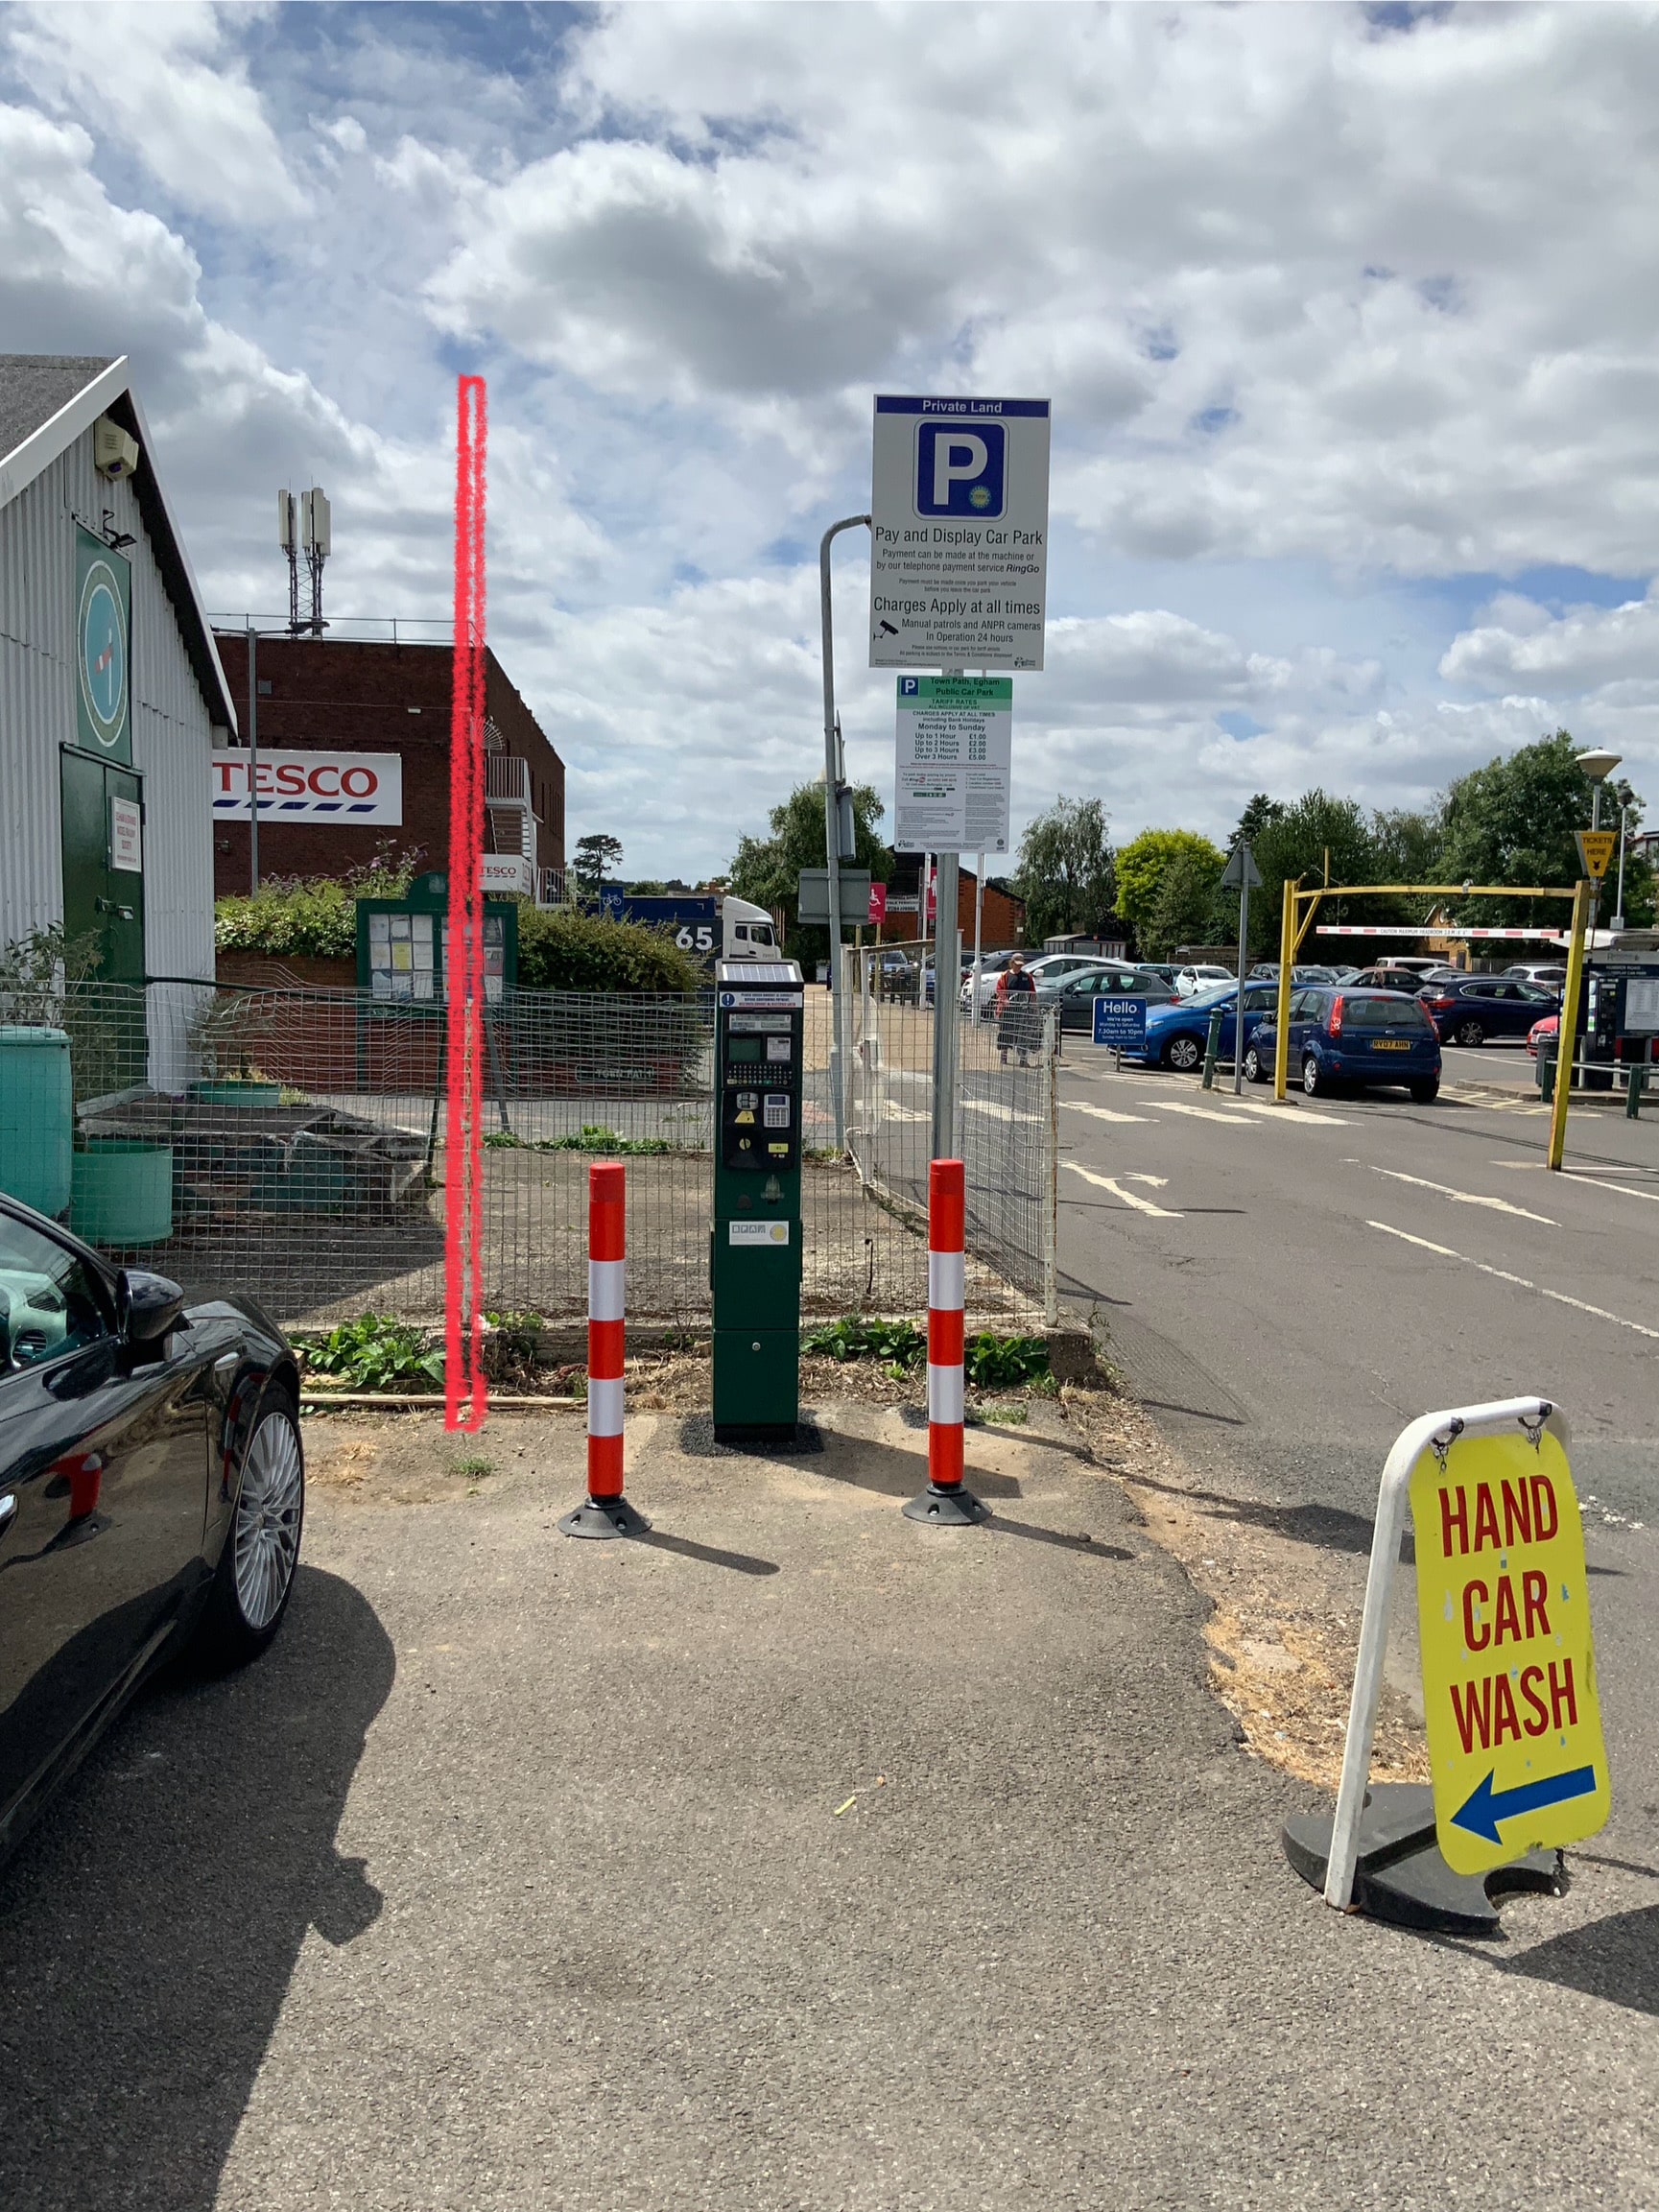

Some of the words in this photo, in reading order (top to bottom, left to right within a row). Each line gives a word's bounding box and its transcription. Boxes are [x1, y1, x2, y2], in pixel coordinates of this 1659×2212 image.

[922, 399, 967, 413] Private
[971, 401, 1003, 414] Land
[933, 433, 988, 505] P
[875, 527, 900, 544] Pay
[904, 528, 929, 542] and
[933, 528, 982, 546] Display
[986, 530, 1008, 544] Car
[1013, 530, 1043, 545] Park
[883, 549, 915, 560] Payment
[934, 550, 942, 559] be
[945, 550, 966, 559] made
[968, 551, 976, 559] at
[978, 551, 990, 560] the
[992, 551, 1024, 560] machine
[877, 560, 887, 571] by
[903, 561, 940, 572] telephone
[942, 562, 976, 573] payment
[977, 563, 1005, 572] service
[1006, 564, 1040, 574] RingGo
[873, 597, 927, 614] Charges
[931, 598, 967, 616] Apply
[971, 601, 983, 614] at
[986, 599, 1001, 614] all
[1006, 600, 1041, 615] times
[902, 618, 931, 630] Manual
[933, 620, 961, 631] patrols
[963, 620, 979, 630] and
[981, 620, 1006, 630] ANPR
[1007, 622, 1042, 631] cameras
[926, 631, 935, 641] In
[936, 631, 976, 643] Operation
[977, 633, 988, 642] 24
[990, 633, 1013, 643] hours
[905, 679, 915, 693] P
[952, 678, 971, 686] Path,
[973, 678, 1000, 687] Egham
[958, 724, 986, 732] Sunday
[212, 762, 378, 798] TESCO
[479, 866, 516, 875] TESCO
[675, 926, 713, 951] 65
[1438, 1474, 1560, 1558] HAND
[1460, 1569, 1552, 1653] CAR
[1449, 1657, 1579, 1755] WASH
